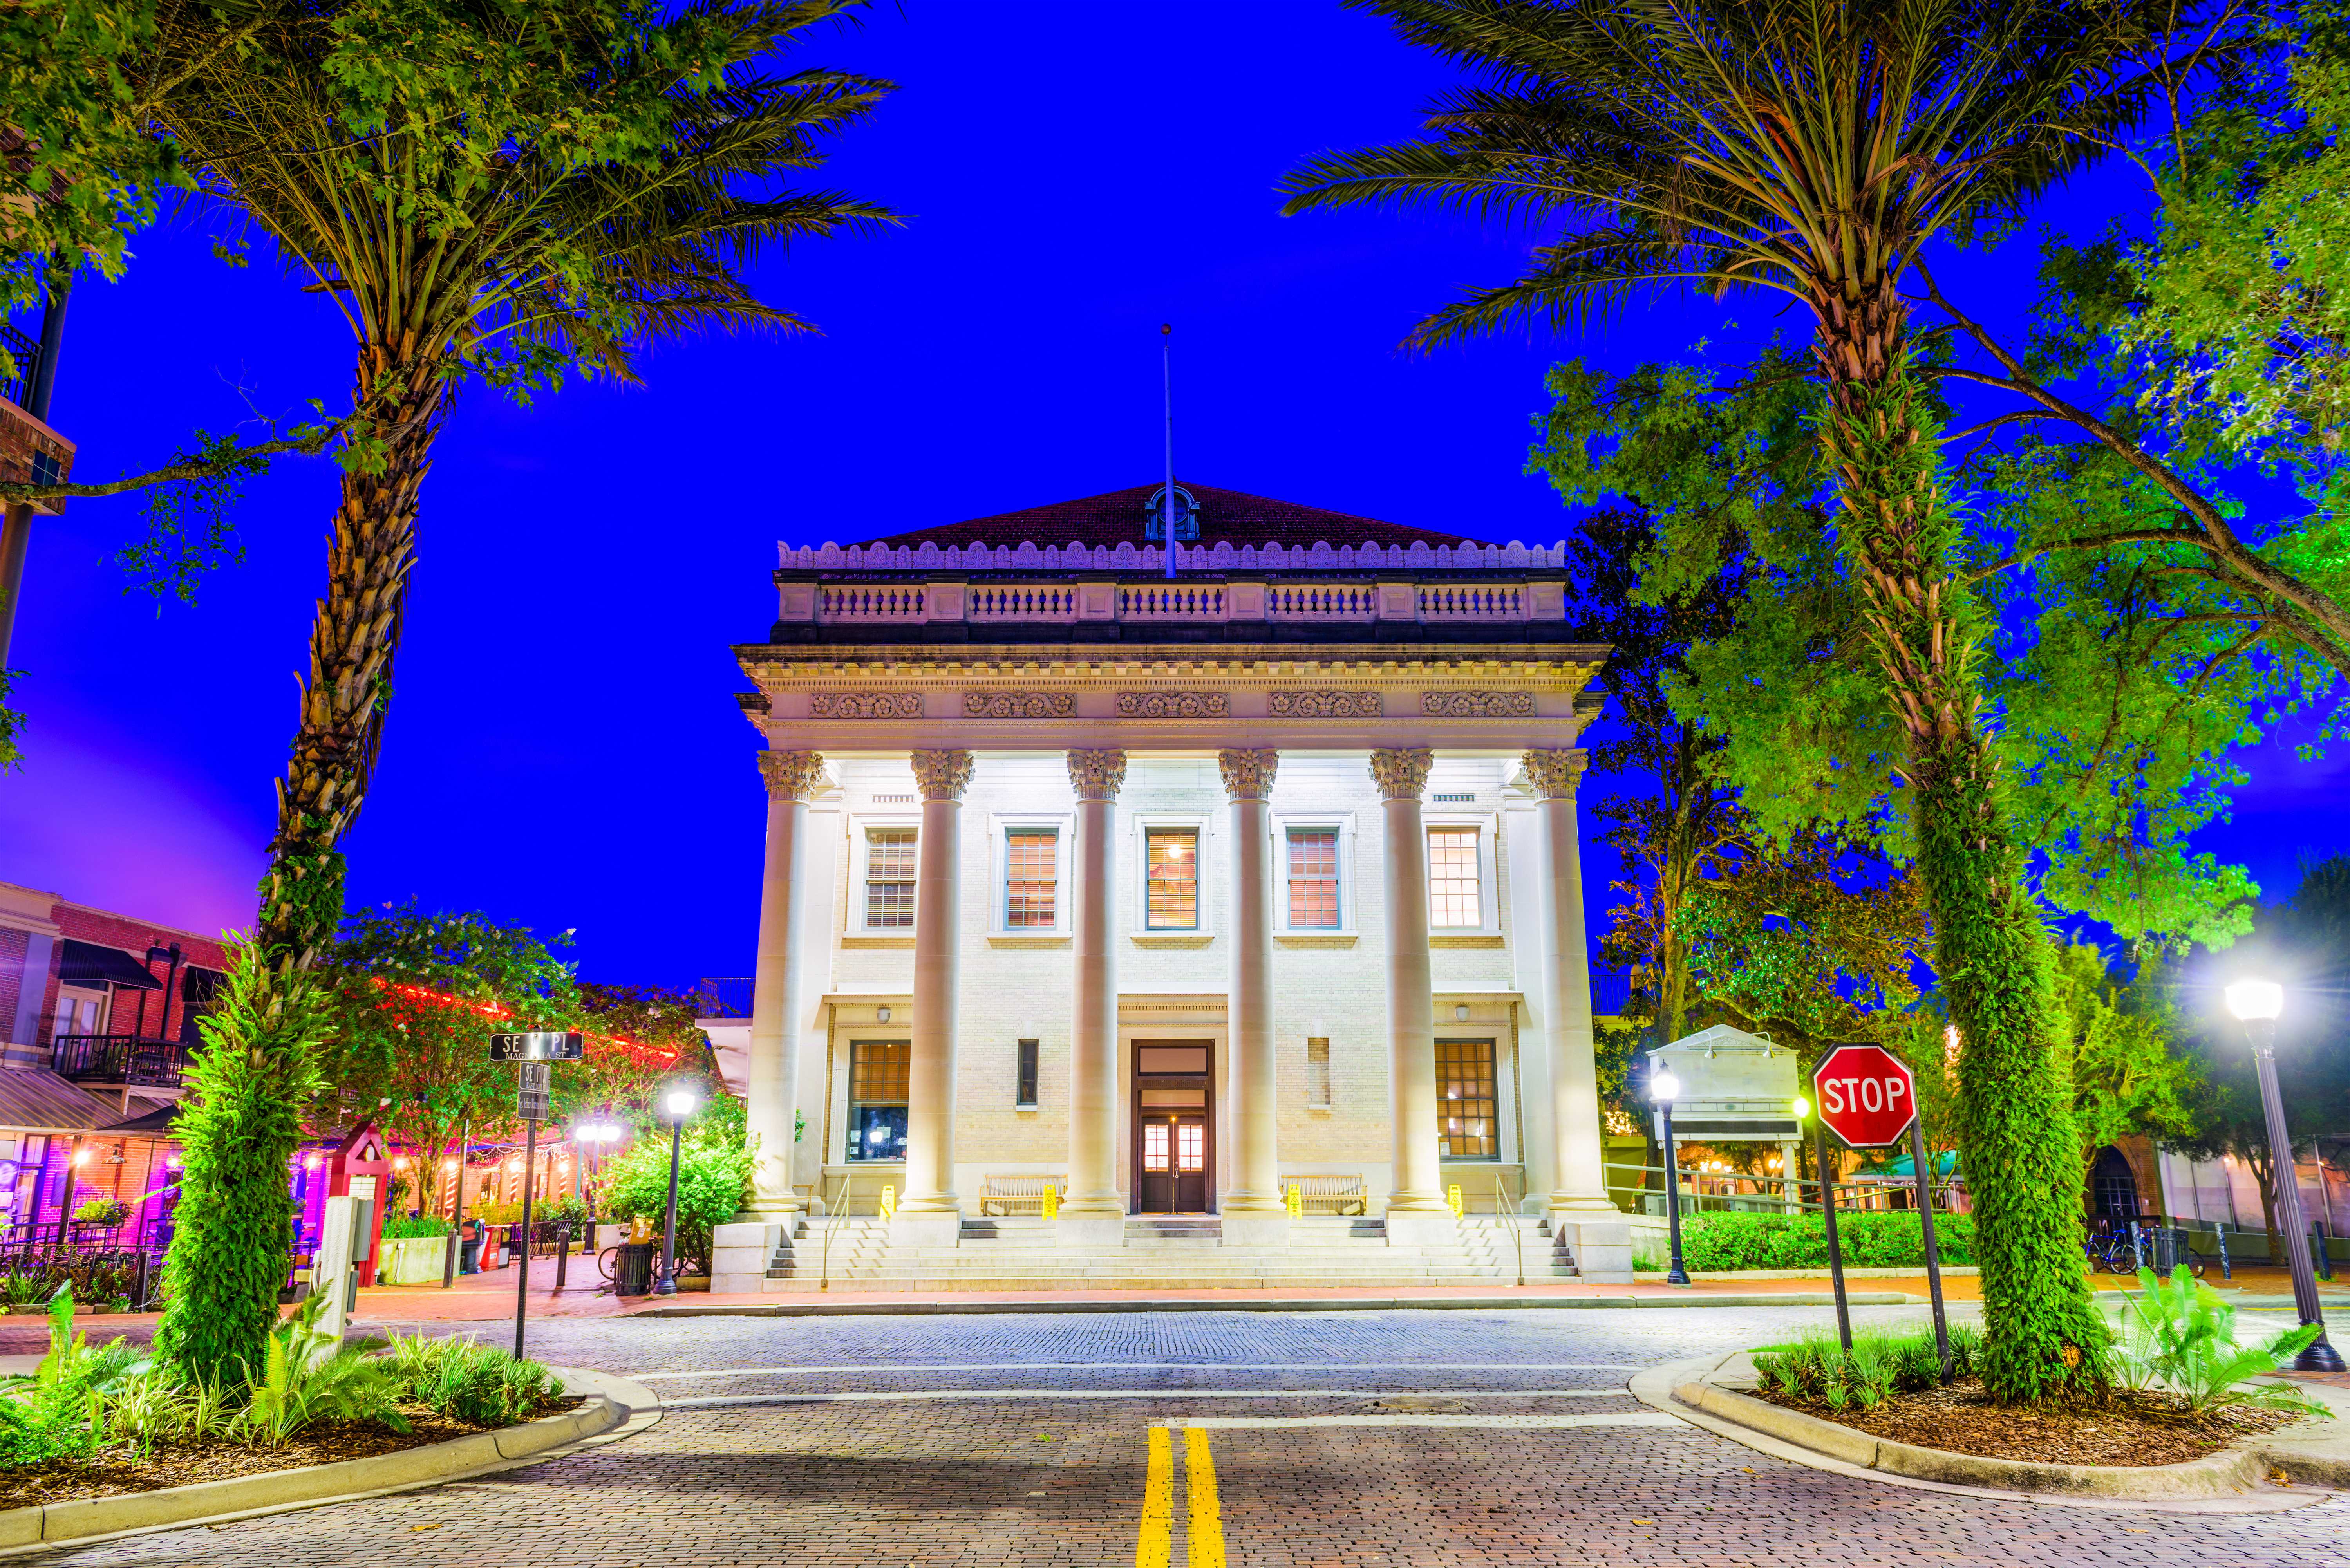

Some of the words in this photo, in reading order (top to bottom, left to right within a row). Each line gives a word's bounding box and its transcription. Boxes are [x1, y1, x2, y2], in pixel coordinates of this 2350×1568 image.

[503, 1036, 520, 1053] SE
[552, 1035, 569, 1051] PL
[525, 1064, 533, 1082] SE
[542, 1067, 548, 1084] ST
[1824, 1077, 1905, 1114] STOP
